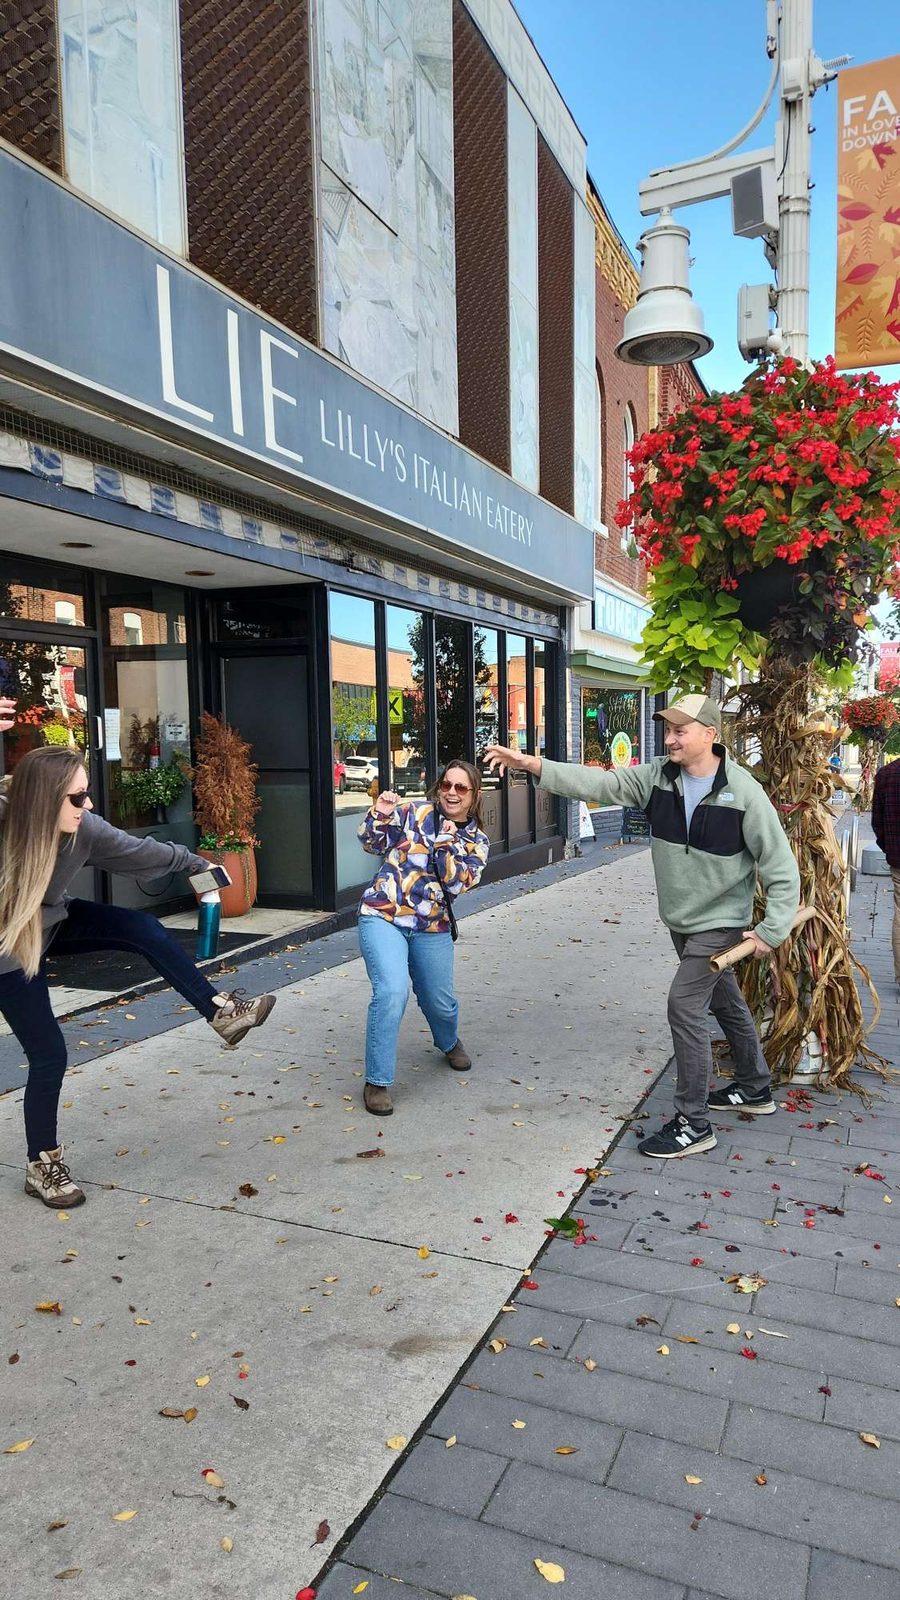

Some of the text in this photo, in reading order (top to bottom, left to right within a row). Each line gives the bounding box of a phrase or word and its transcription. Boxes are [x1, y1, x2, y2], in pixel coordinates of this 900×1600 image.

[842, 125, 858, 139] IN
[842, 128, 900, 152] DOWN
[156, 263, 304, 464] LIE
[319, 399, 534, 547] LILLY'S ITALIAN EATERY
